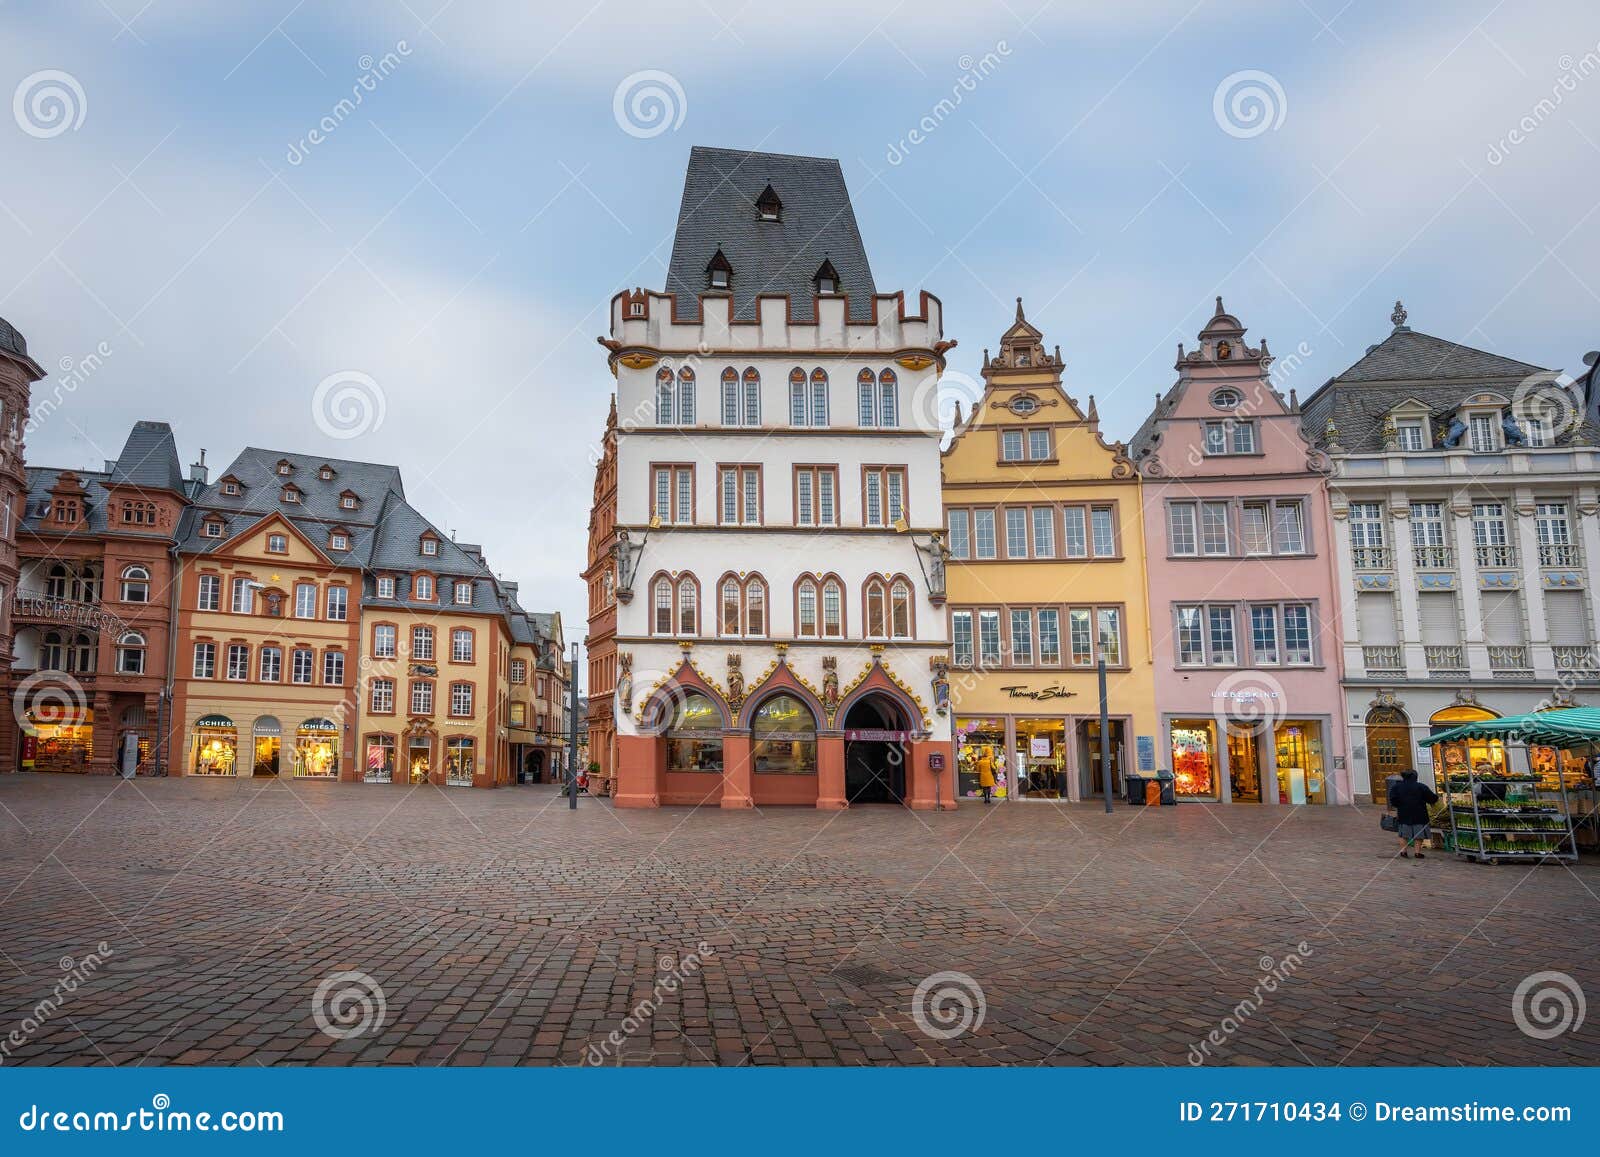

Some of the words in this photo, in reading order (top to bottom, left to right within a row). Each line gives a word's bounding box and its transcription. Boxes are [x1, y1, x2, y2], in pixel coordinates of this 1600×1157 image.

[12, 597, 120, 634] LEISCHSTRASSE
[1000, 686, 1040, 700] Thomas
[1037, 686, 1078, 701] Sabo
